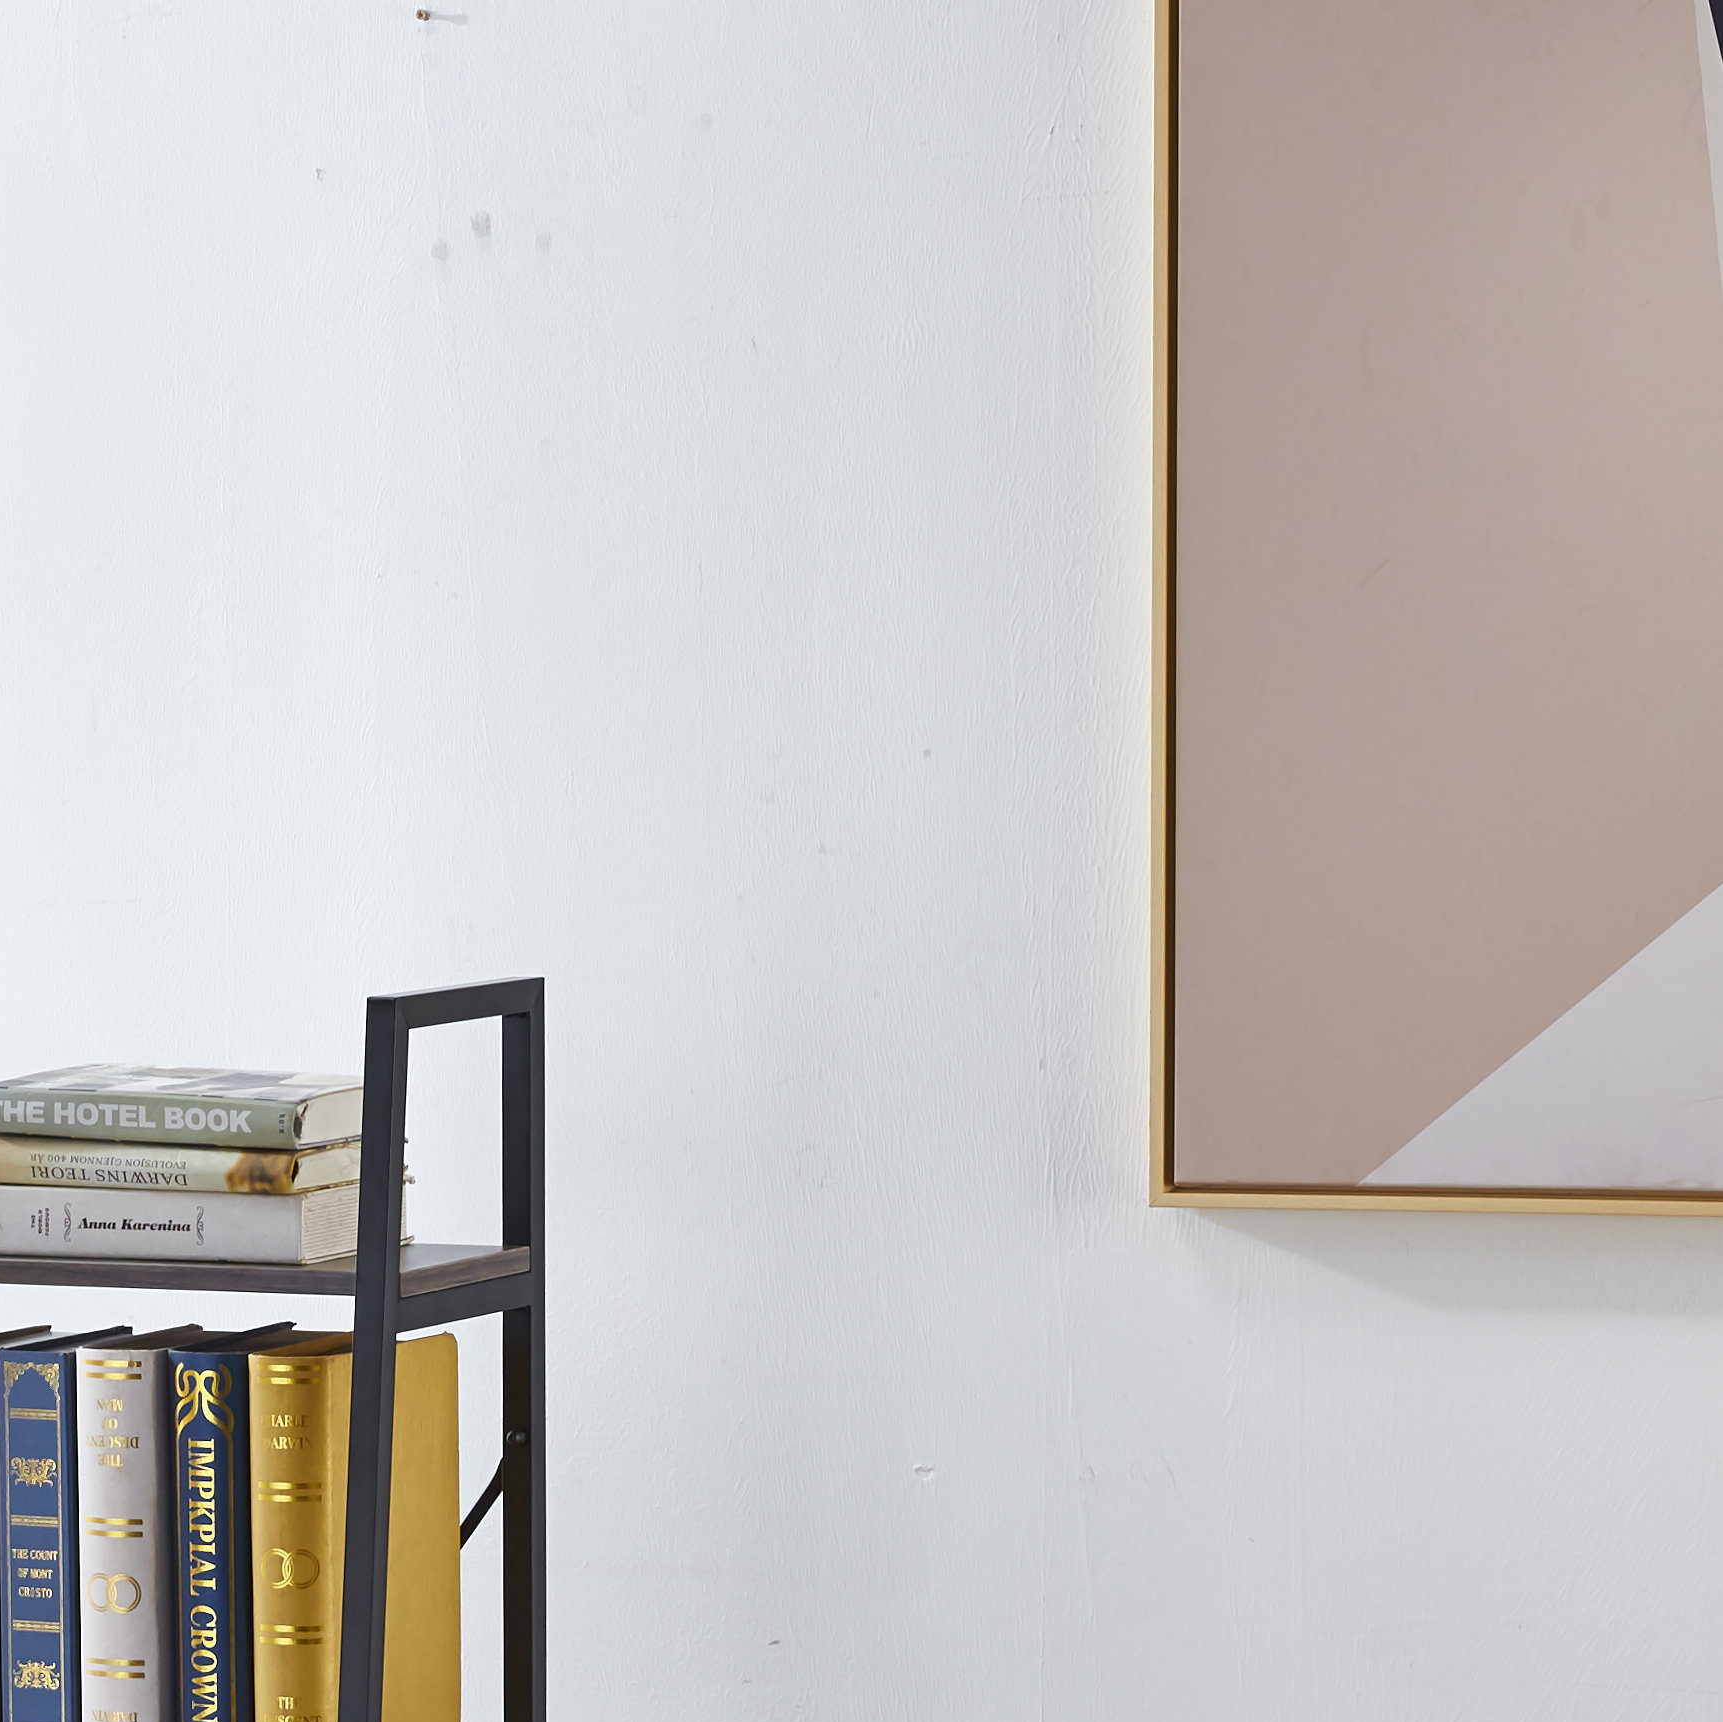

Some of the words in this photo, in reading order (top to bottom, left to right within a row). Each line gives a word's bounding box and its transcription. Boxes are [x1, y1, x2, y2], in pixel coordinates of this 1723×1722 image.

[54, 1102, 156, 1128] HOTEL
[164, 1106, 252, 1133] BOOK
[47, 1154, 67, 1163] 400
[70, 1155, 122, 1167] GJENNOM
[125, 1158, 187, 1170] EVOLUSJON
[30, 1165, 91, 1181] TEORI
[96, 1168, 188, 1186] DARWINS
[77, 1217, 117, 1230] Anna
[121, 1218, 191, 1232] Karenina
[12, 1548, 29, 1559] THE
[29, 1550, 58, 1561] COUNT
[30, 1568, 53, 1579] MONT
[18, 1586, 53, 1599] CRISTO
